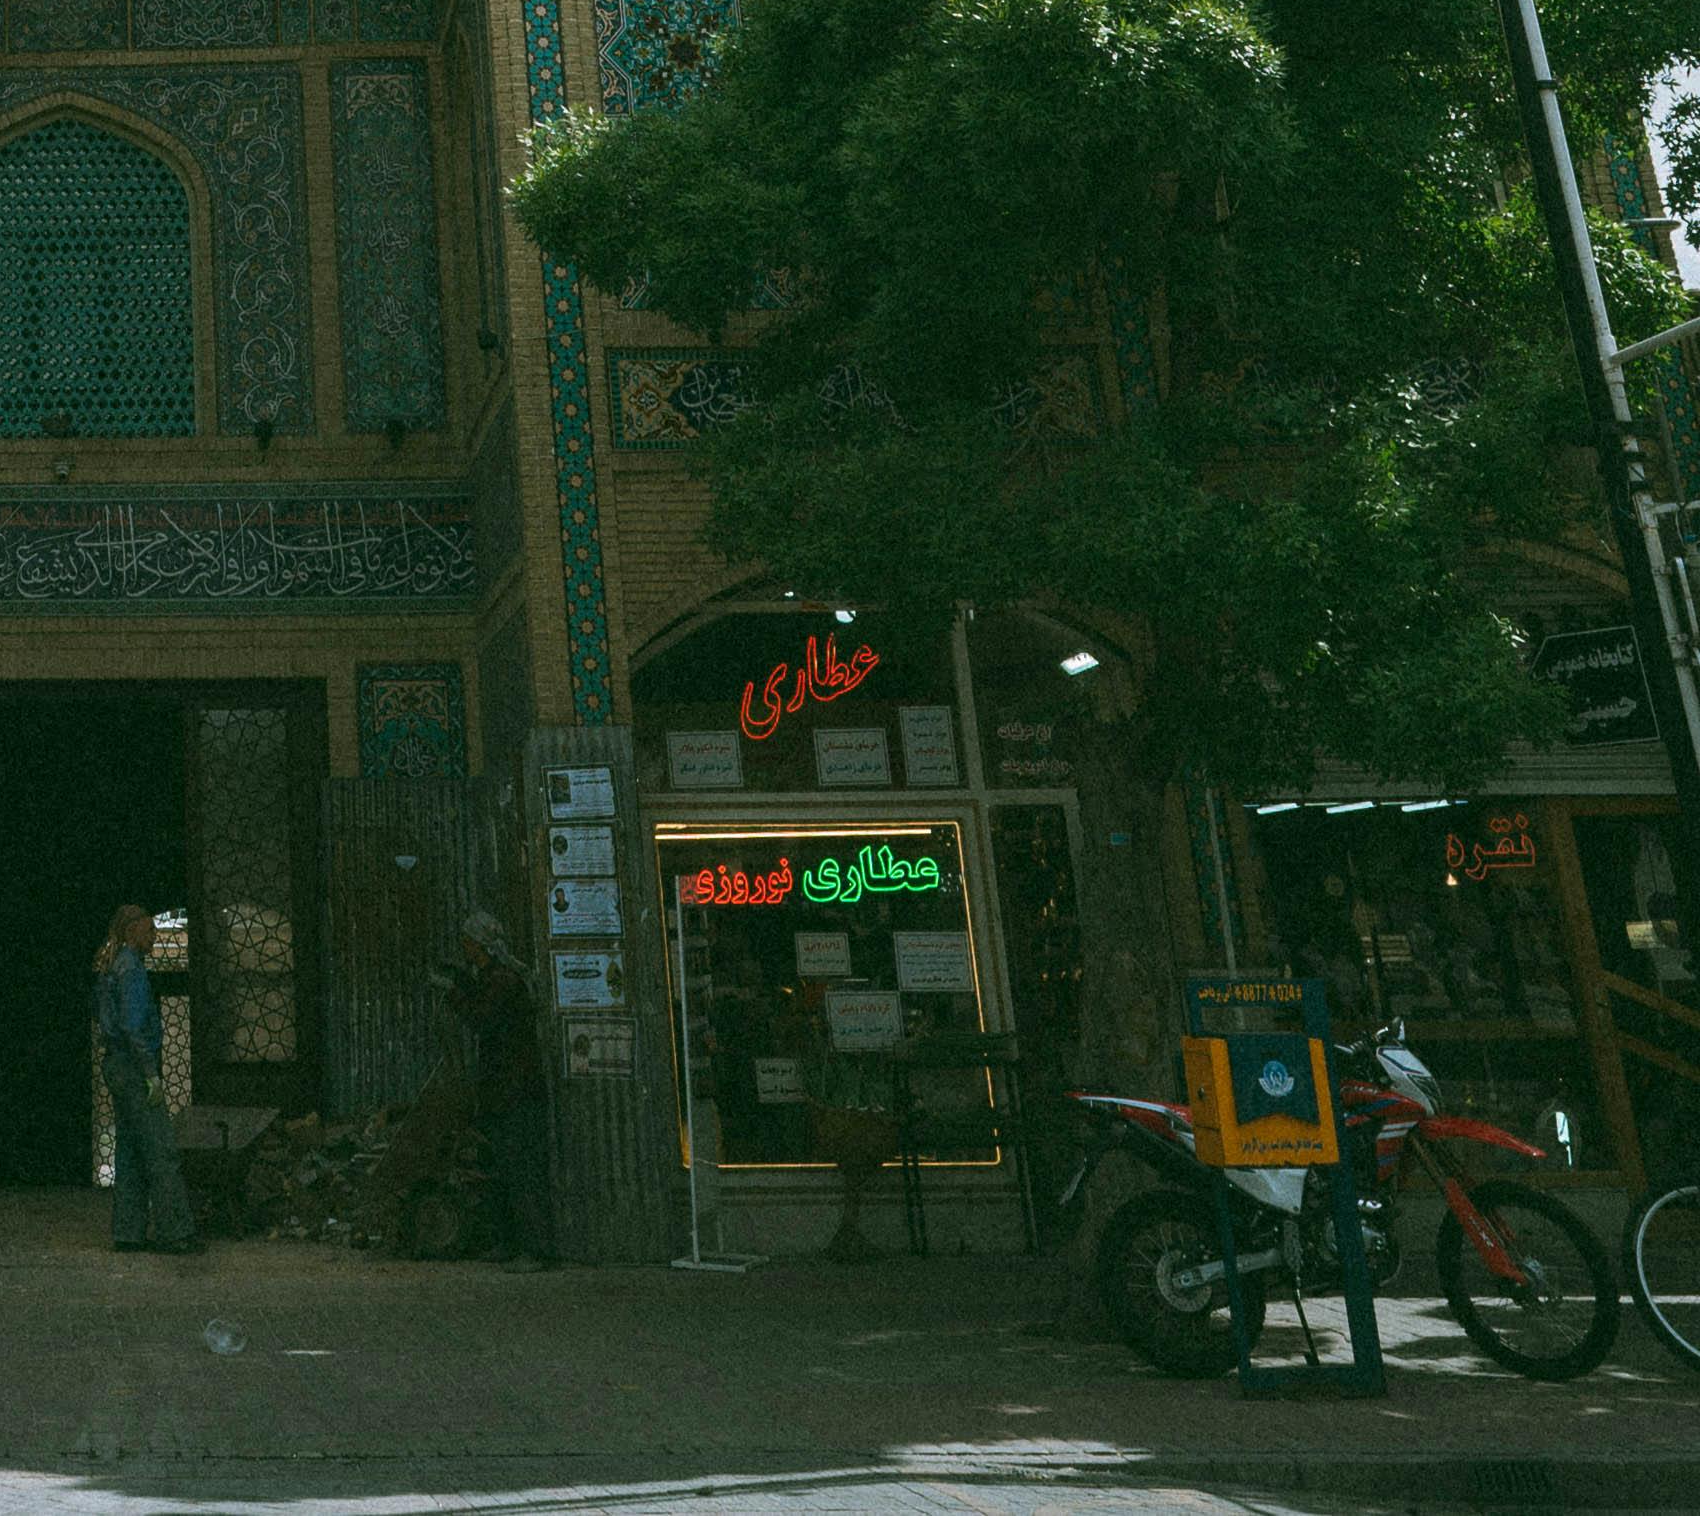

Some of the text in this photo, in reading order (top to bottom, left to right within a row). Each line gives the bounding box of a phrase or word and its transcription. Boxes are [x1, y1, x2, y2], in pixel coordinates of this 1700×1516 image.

[739, 631, 882, 741] عطاری
[690, 844, 940, 905] عطاری نوروزی
[1445, 812, 1538, 883] نقره
